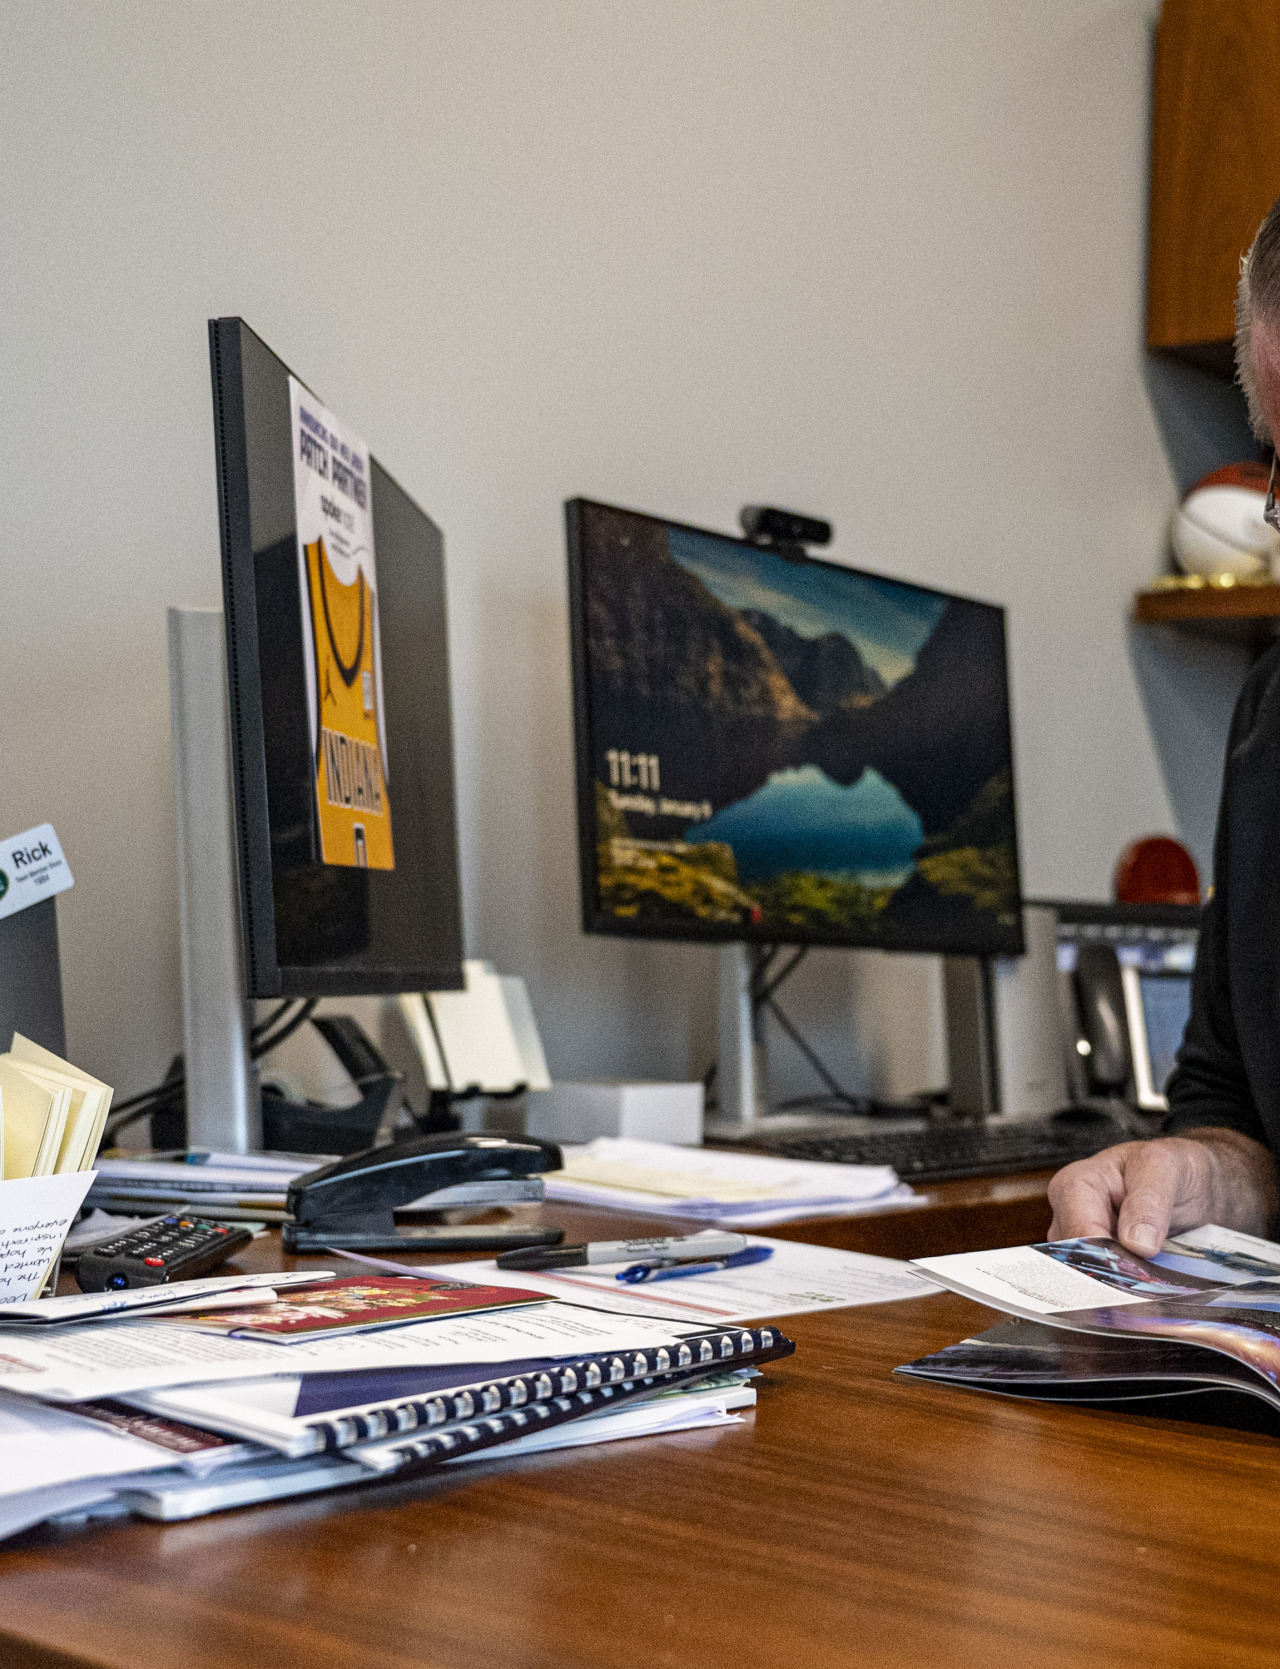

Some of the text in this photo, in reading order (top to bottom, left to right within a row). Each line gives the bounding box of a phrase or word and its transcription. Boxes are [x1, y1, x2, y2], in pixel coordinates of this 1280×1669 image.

[320, 725, 385, 818] INDIANA
[606, 748, 660, 791] 11:11
[11, 841, 52, 869] Rick
[13, 1219, 68, 1233] everyone
